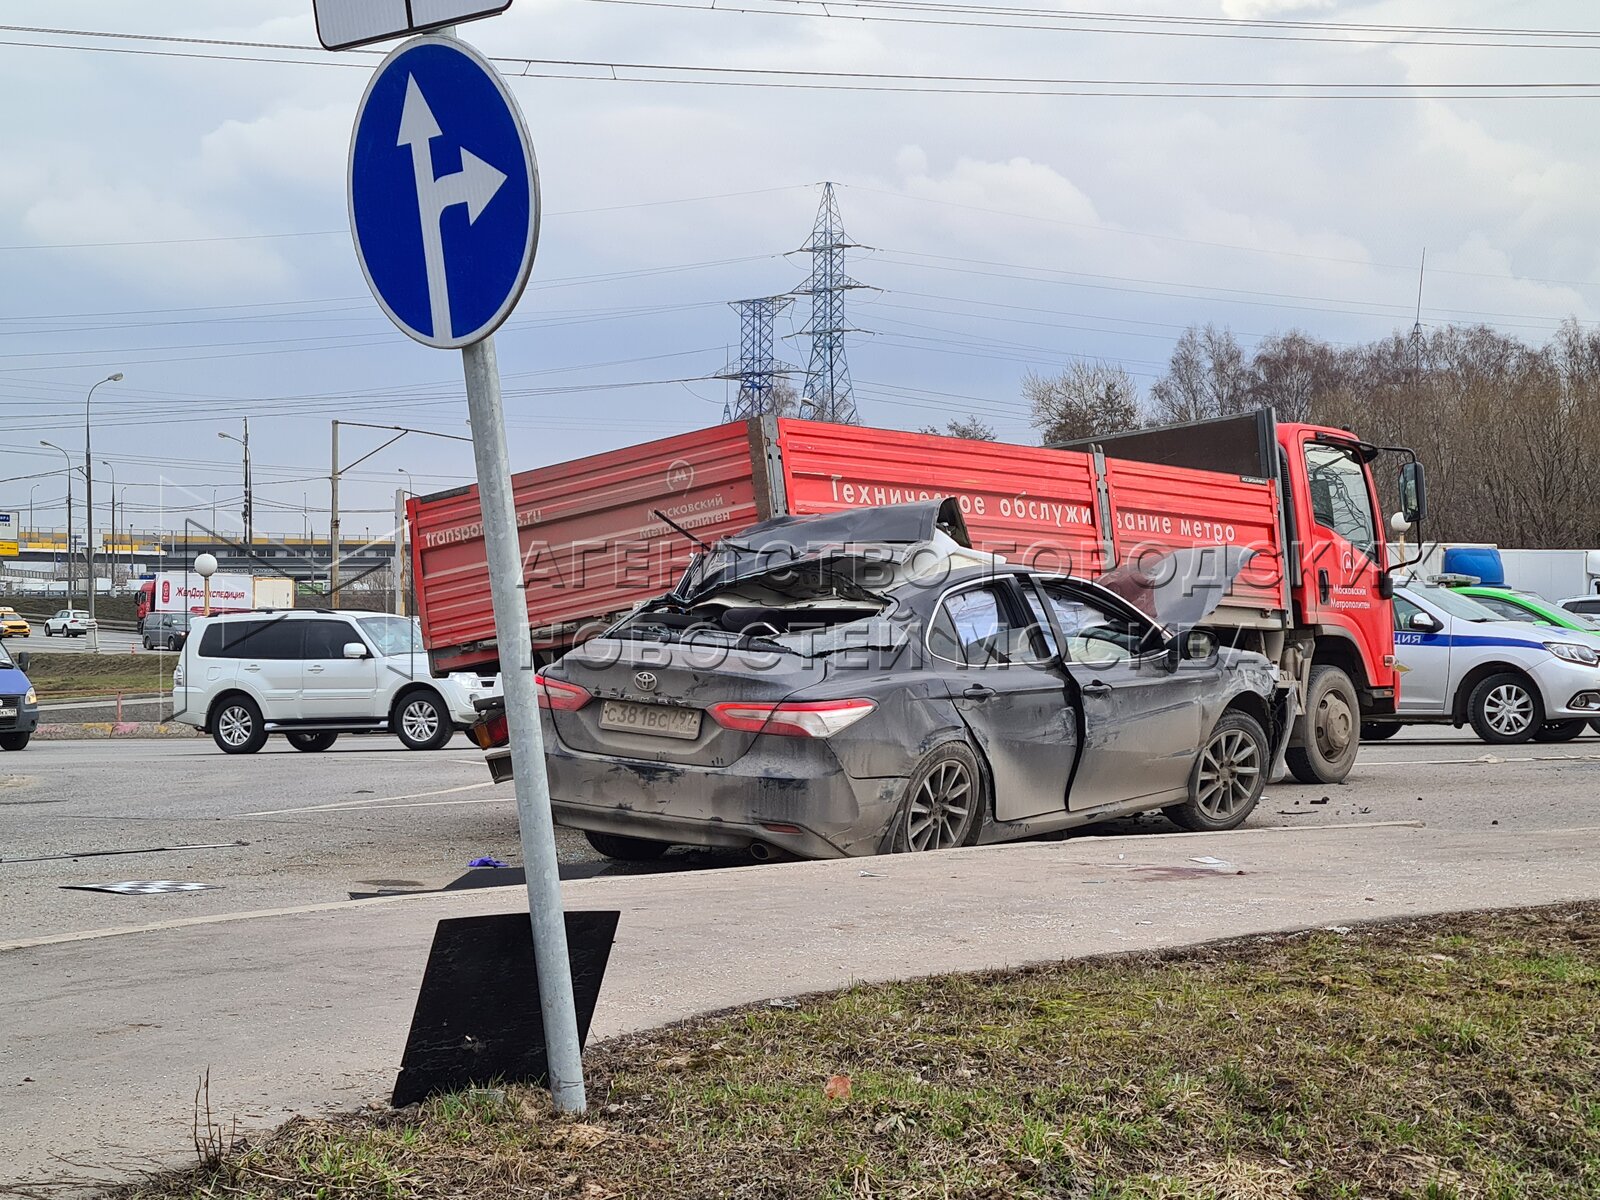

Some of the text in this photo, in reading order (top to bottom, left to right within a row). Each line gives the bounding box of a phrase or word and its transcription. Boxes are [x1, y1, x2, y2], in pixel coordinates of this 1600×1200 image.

[647, 493, 724, 522] Московский
[831, 474, 986, 515] Техничеое
[1180, 518, 1236, 545] метро
[1332, 583, 1367, 596] Московский
[1330, 598, 1371, 611] Метрополитен
[1393, 633, 1422, 644] ЦИЯ
